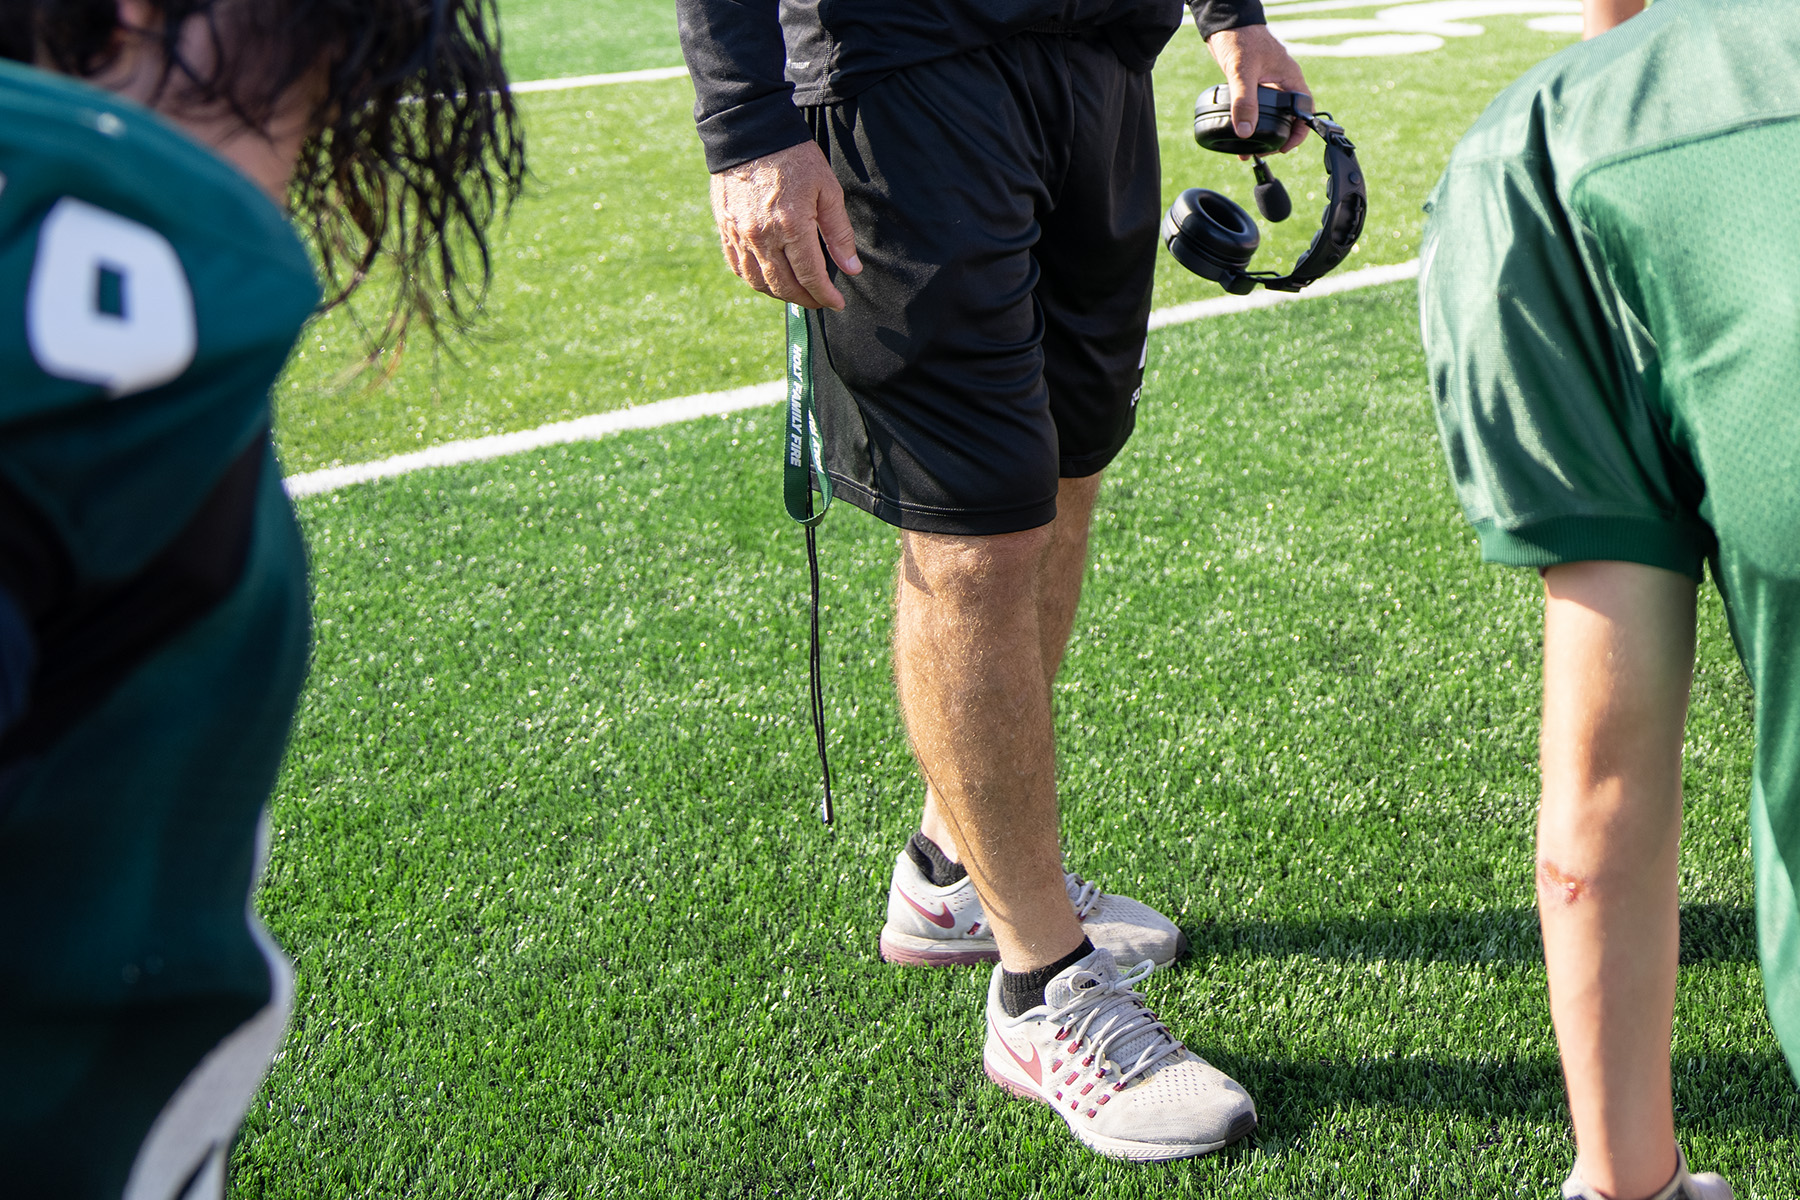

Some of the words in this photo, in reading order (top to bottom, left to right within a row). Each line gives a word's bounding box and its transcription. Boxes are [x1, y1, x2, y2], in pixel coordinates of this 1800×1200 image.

[791, 343, 803, 383] HOLY
[790, 381, 803, 435] FAMILY
[789, 432, 803, 468] FIRE
